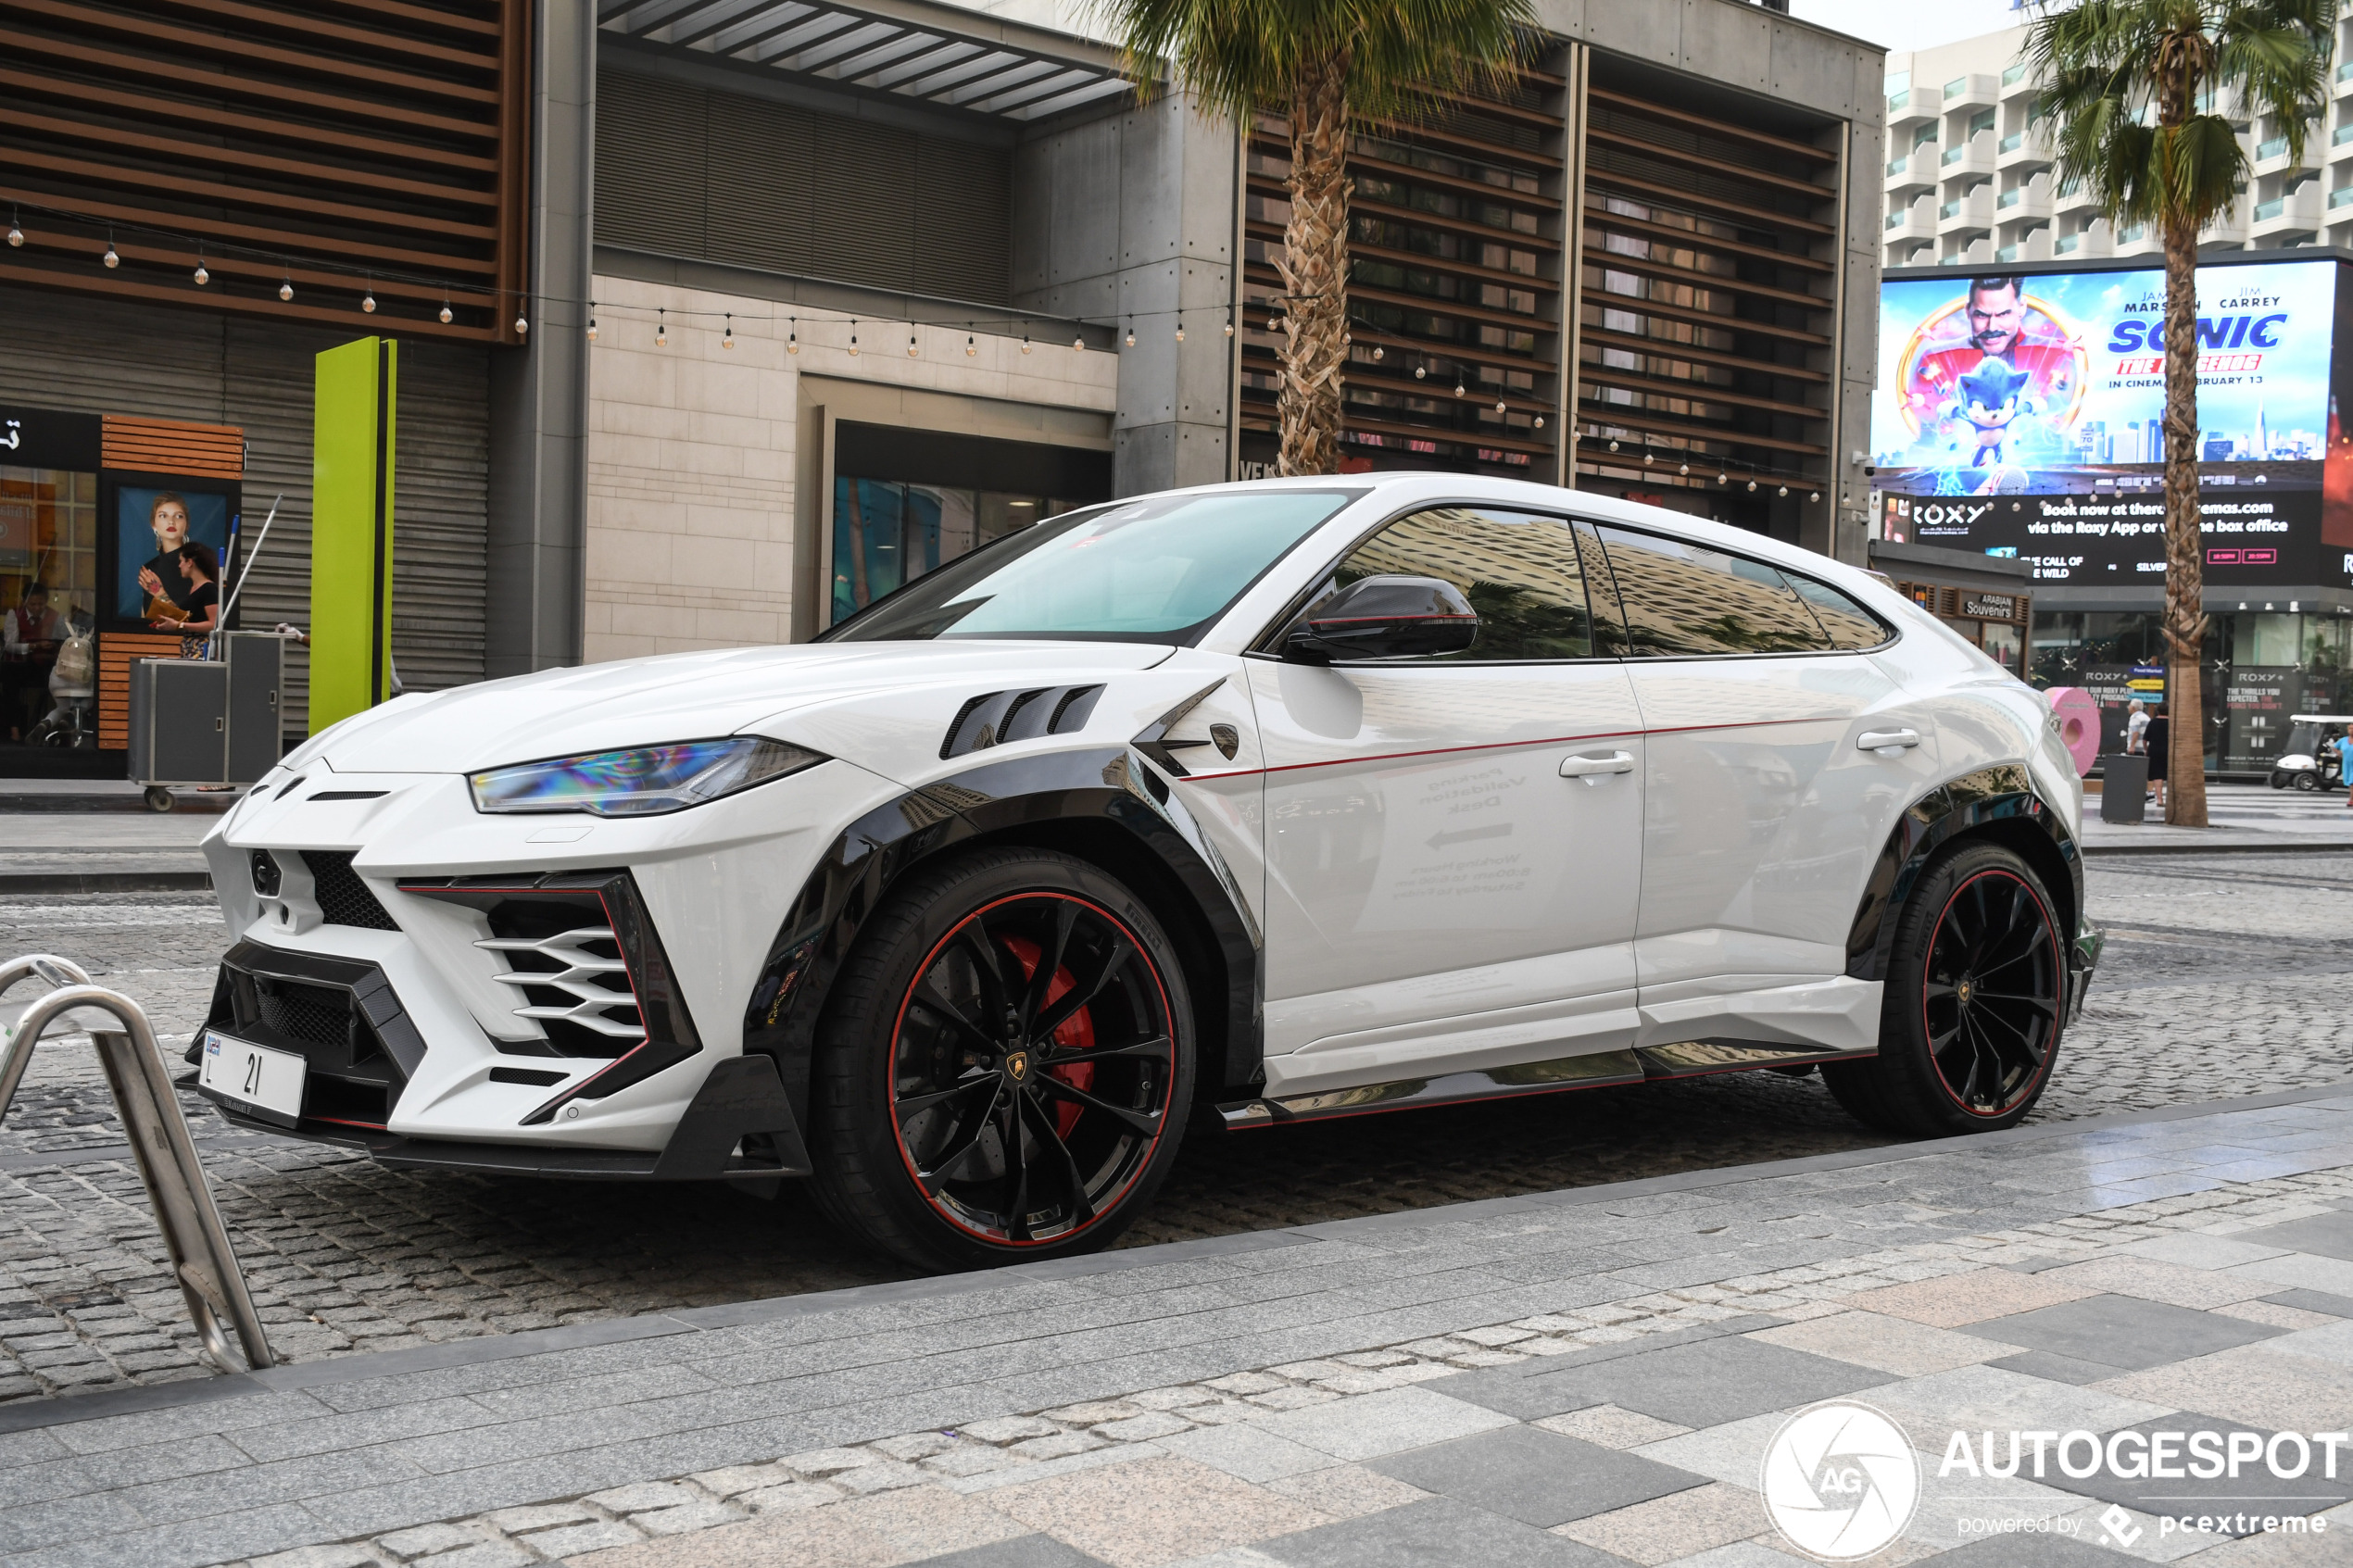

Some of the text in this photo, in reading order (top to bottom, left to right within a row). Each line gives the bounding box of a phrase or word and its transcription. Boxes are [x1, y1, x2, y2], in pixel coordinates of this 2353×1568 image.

[2238, 287, 2261, 297] JIM
[2220, 296, 2281, 308] CARREY
[2120, 358, 2156, 374] THE
[2126, 378, 2165, 387] CINEM
[2043, 504, 2078, 516] Book
[2080, 506, 2109, 516] now
[2111, 504, 2128, 515] at
[2028, 521, 2049, 534] via
[2051, 521, 2074, 533] the
[2075, 521, 2108, 536] Roxy
[2110, 521, 2140, 536] App
[2142, 523, 2158, 533] or
[2216, 520, 2244, 533] box
[2246, 519, 2288, 533] office
[2043, 557, 2067, 566] CALL
[2069, 557, 2083, 566] OF
[2042, 569, 2070, 578] WILD
[1982, 595, 2012, 607] ARABIAN
[1967, 601, 2011, 618] Souvenirs
[2086, 672, 2121, 681] ROXY
[2238, 673, 2276, 682] ROXY
[206, 1052, 262, 1096] L 21
[228, 1098, 247, 1114] MANSORY
